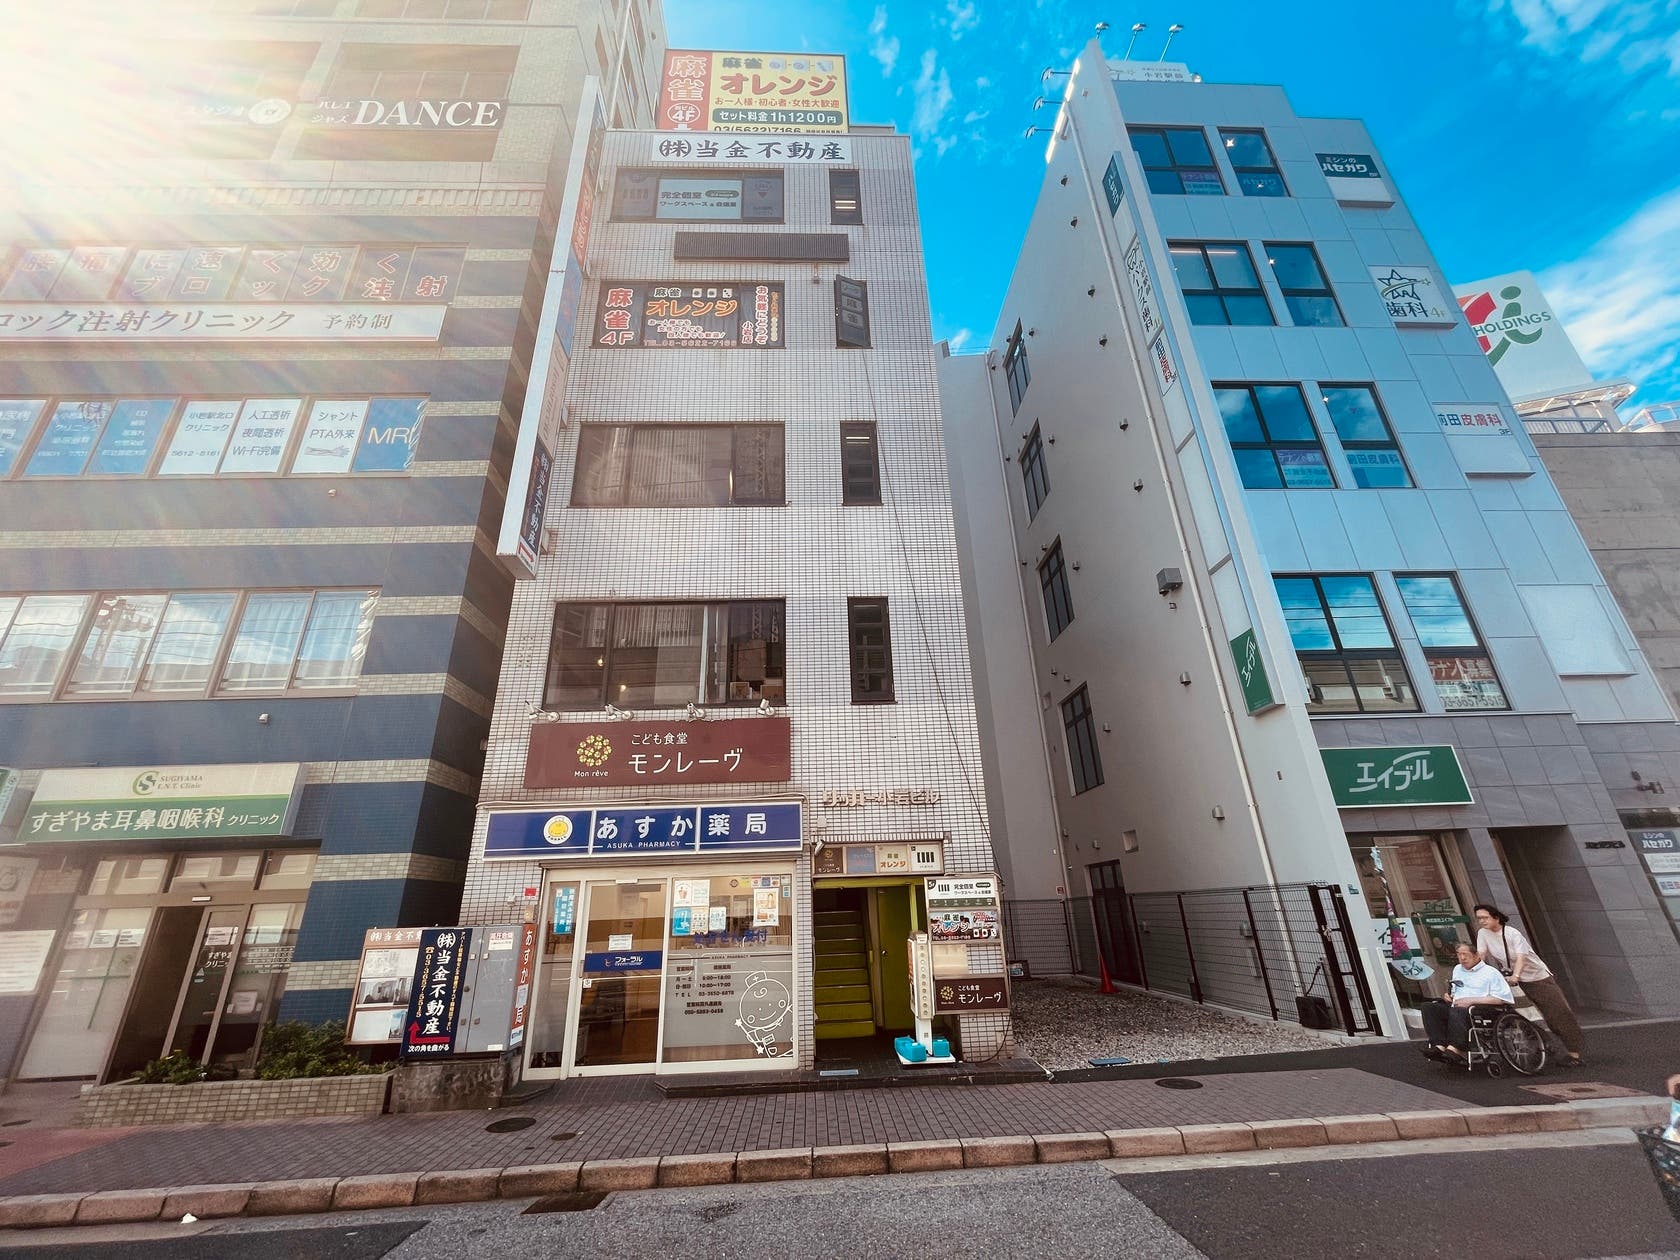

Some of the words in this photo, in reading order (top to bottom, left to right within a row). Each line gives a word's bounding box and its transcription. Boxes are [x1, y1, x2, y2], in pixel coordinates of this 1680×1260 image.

[722, 57, 763, 69] 麻雀
[668, 55, 707, 101] 麻雀
[720, 73, 838, 96] オレンジ
[352, 100, 501, 127] DANCE
[673, 110, 696, 121] 4F
[1323, 163, 1367, 172] ハセガワ
[654, 287, 681, 297] 麻雀
[605, 288, 633, 330] 麻雀
[646, 299, 738, 317] オレンジ
[755, 286, 768, 345] お気軽にどうぞ
[1387, 302, 1428, 318] 歯科
[323, 314, 392, 330] 予約制
[1472, 311, 1551, 336] HOLDINGS
[600, 331, 634, 345] 4F
[742, 321, 753, 345] 小岩店
[319, 411, 358, 422] シャント
[1437, 413, 1502, 427] 前田皮膚科
[184, 423, 230, 432] クリニック
[1347, 452, 1400, 465] 前田皮膚科
[631, 732, 688, 745] こども食堂
[628, 748, 743, 774] モンレーヴ
[1352, 752, 1434, 792] エイブル
[31, 807, 225, 834] すぎやま耳鼻咽喉科
[227, 813, 280, 826] クリニック
[596, 812, 767, 840] あすか薬局
[638, 840, 681, 848] PHARMACY
[1642, 840, 1673, 848] ハセガワ
[943, 913, 961, 922] 麻雀
[931, 921, 970, 933] オレンジ
[515, 930, 533, 1025] あすか局
[958, 992, 1002, 1004] モンレーヴ
